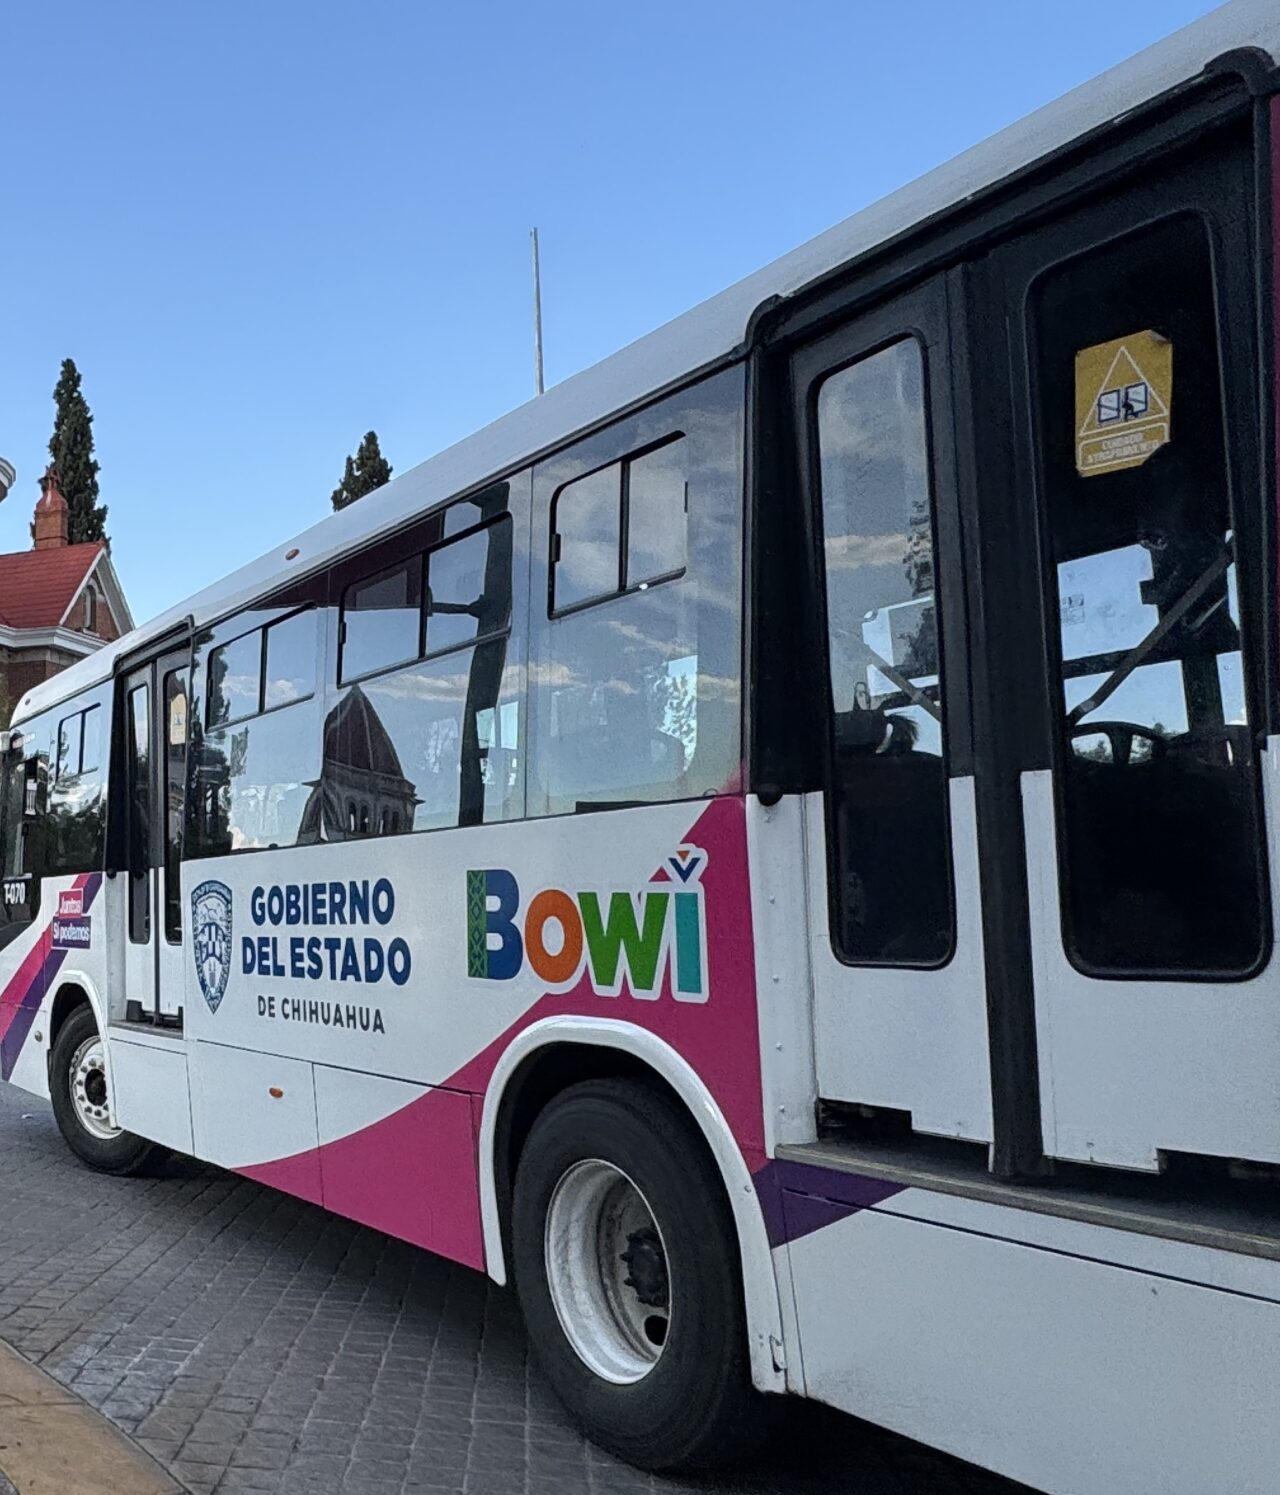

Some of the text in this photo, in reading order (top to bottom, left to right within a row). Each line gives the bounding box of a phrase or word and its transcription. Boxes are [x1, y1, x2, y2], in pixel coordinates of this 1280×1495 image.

[3, 882, 26, 905] T-070
[251, 877, 396, 927] GOBIERNO
[60, 922, 90, 943] podemos
[241, 936, 412, 986] DEL ESTADO
[257, 995, 386, 1034] DE CHIHUAHUA
